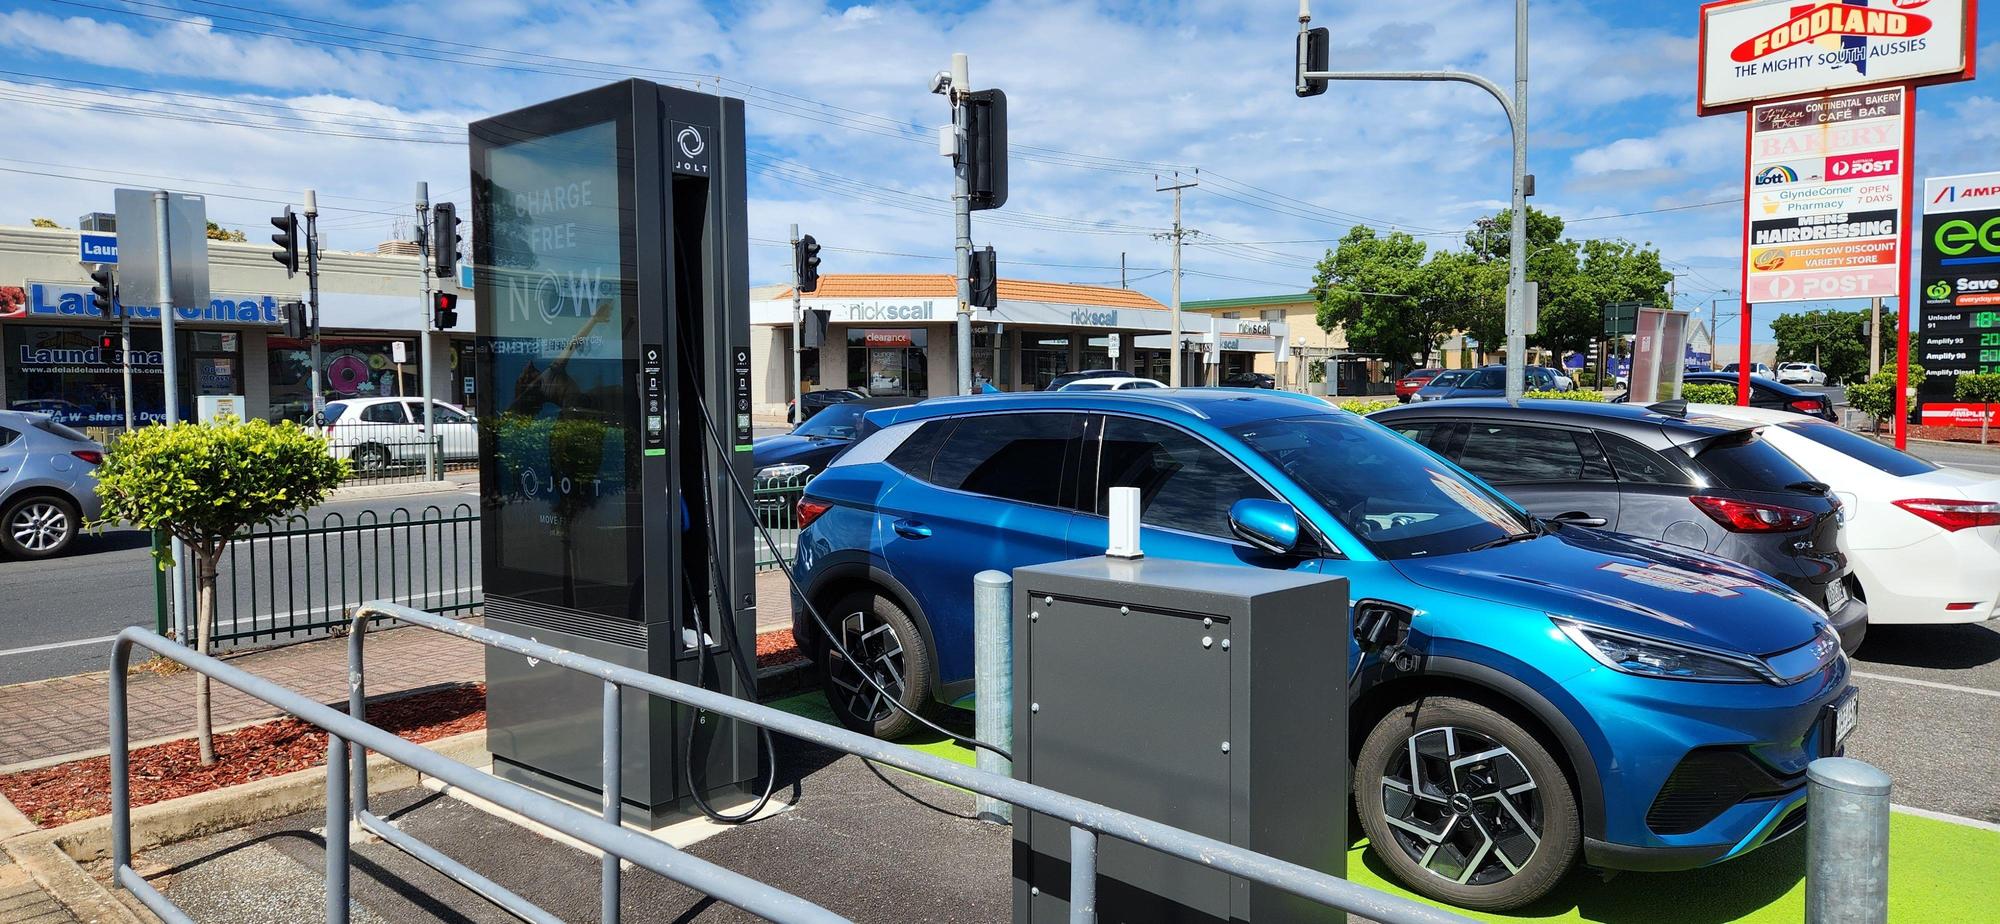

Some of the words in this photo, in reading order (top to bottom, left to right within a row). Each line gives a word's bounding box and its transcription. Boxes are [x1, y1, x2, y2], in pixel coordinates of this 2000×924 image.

[1754, 7, 1907, 57] FOODLAND
[1735, 63, 1757, 78] THE
[1762, 55, 1814, 74] MIGHTY
[1818, 46, 1866, 66] SOUTH
[1870, 38, 1926, 58] AUSSIES
[1805, 98, 1861, 112] CONTINENTAL
[1865, 93, 1900, 105] BAKERY
[1859, 106, 1886, 117] BAR
[1772, 119, 1799, 129] PLACE
[1761, 124, 1896, 157] BAKERY
[676, 162, 708, 173] JOLT
[1852, 160, 1893, 174] POST
[1755, 173, 1783, 186] Lott
[1859, 185, 1889, 194] OPEN
[515, 180, 592, 217] CHARGE
[1865, 194, 1892, 203] DAYS
[1788, 200, 1844, 212] Pharmacy
[1798, 213, 1848, 226] MENS
[531, 222, 577, 253] FREE
[1756, 220, 1892, 244] HAIRDRESSING
[1790, 246, 1844, 257] FELIXSTOW
[1845, 243, 1895, 253] DISCOUNT
[1805, 257, 1844, 267] VARIETY
[1846, 255, 1877, 264] STORE
[1803, 274, 1873, 294] POST
[1957, 278, 1998, 290] Save
[1927, 338, 1954, 346] Amplify
[1926, 352, 1955, 360] Amplify
[1926, 369, 1953, 377] Amplify
[547, 475, 601, 497] JOT
